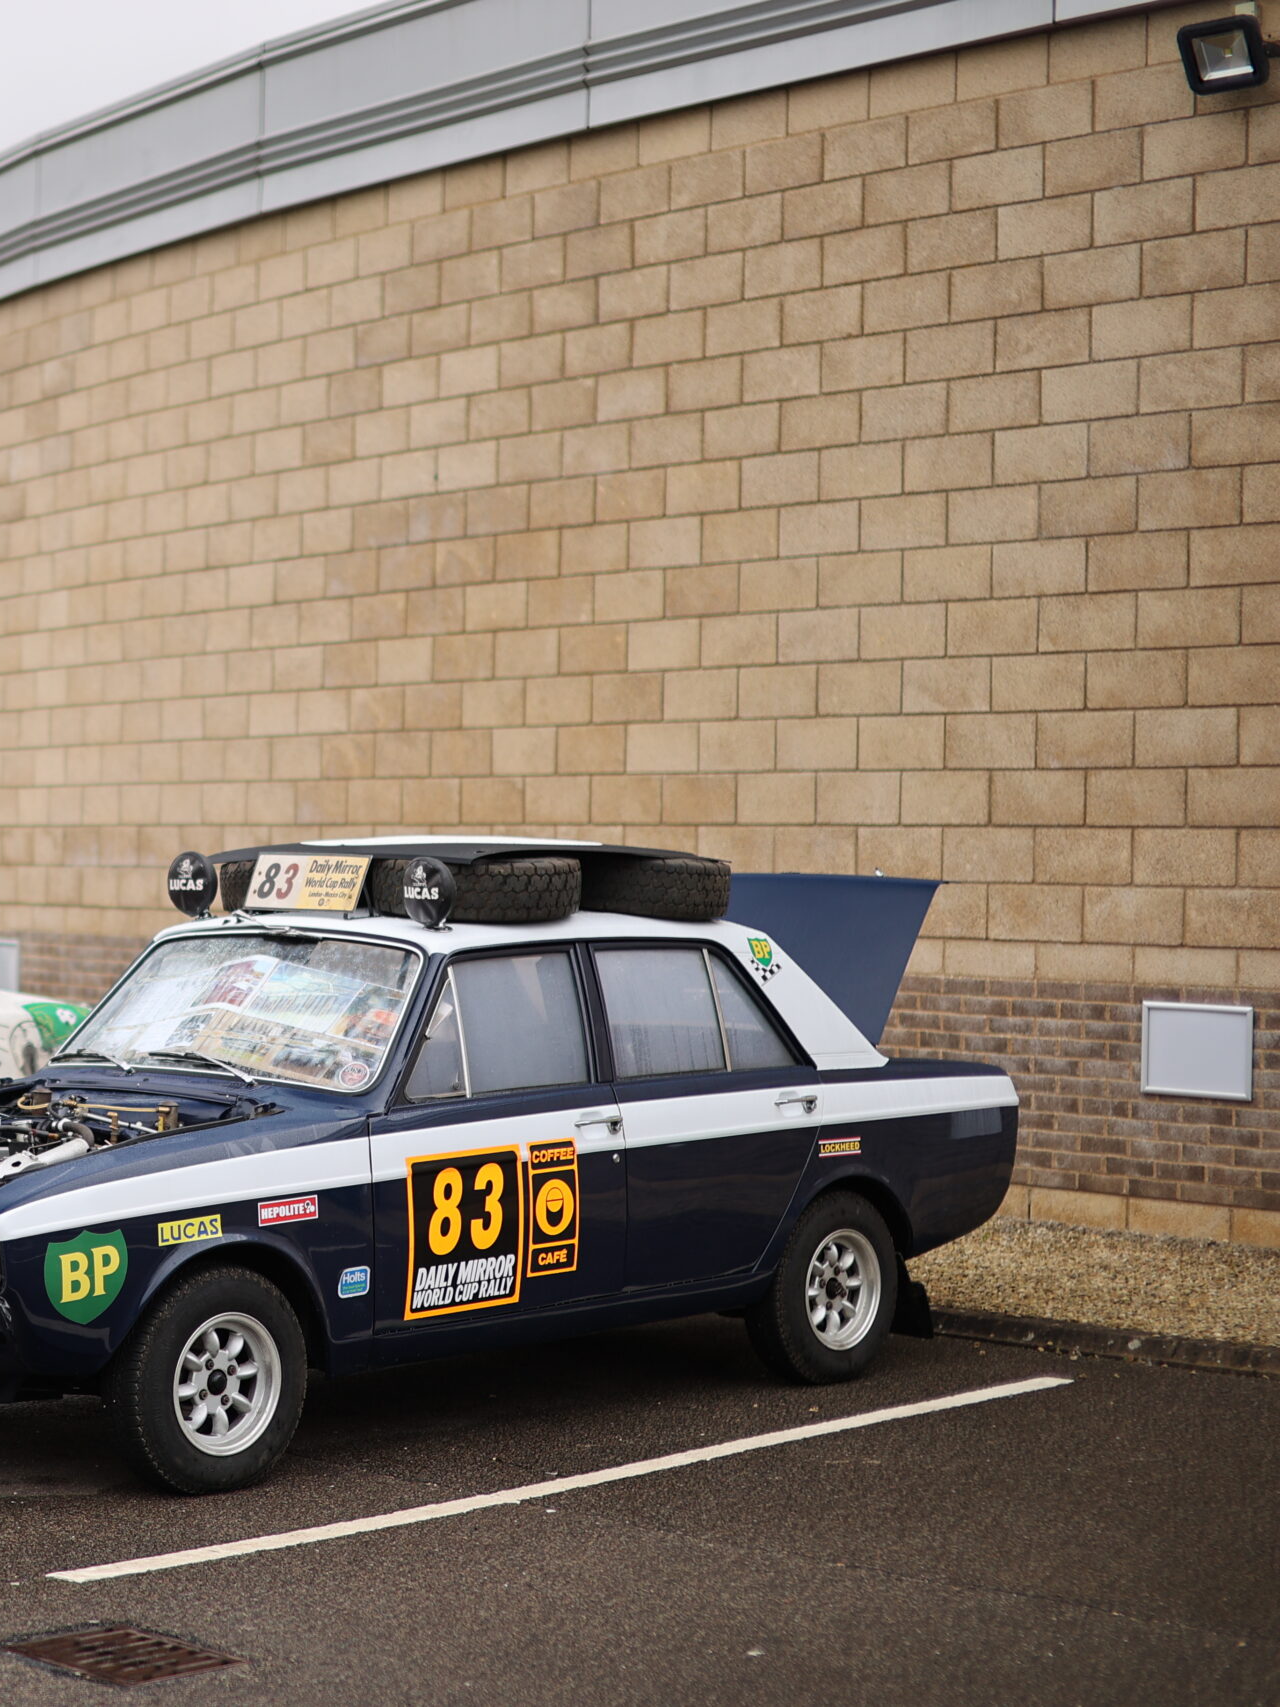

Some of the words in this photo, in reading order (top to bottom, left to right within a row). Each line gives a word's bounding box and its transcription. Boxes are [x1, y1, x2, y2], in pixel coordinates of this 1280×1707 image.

[309, 860, 332, 876] Daily
[332, 860, 362, 878] Mirror
[169, 878, 204, 891] LUCAS
[257, 862, 300, 900] 83
[305, 876, 325, 888] World
[326, 878, 339, 890] Cup
[340, 877, 358, 891] Rally
[403, 885, 440, 900] LUCAS
[750, 939, 771, 960] BP
[532, 1147, 574, 1164] COFFEE
[820, 1142, 861, 1154] LOCKHEED
[261, 1202, 305, 1220] HEPOLITE
[428, 1162, 505, 1256] 83
[160, 1218, 220, 1244] LUCAS
[538, 1248, 568, 1266] CAFÉ
[58, 1245, 121, 1304] BP
[342, 1271, 366, 1285] Holts
[415, 1261, 460, 1292] DAILY
[456, 1253, 516, 1286] MIRROR
[412, 1287, 454, 1310] WORLD
[455, 1281, 480, 1303] CUP
[478, 1275, 514, 1299] RALLY
